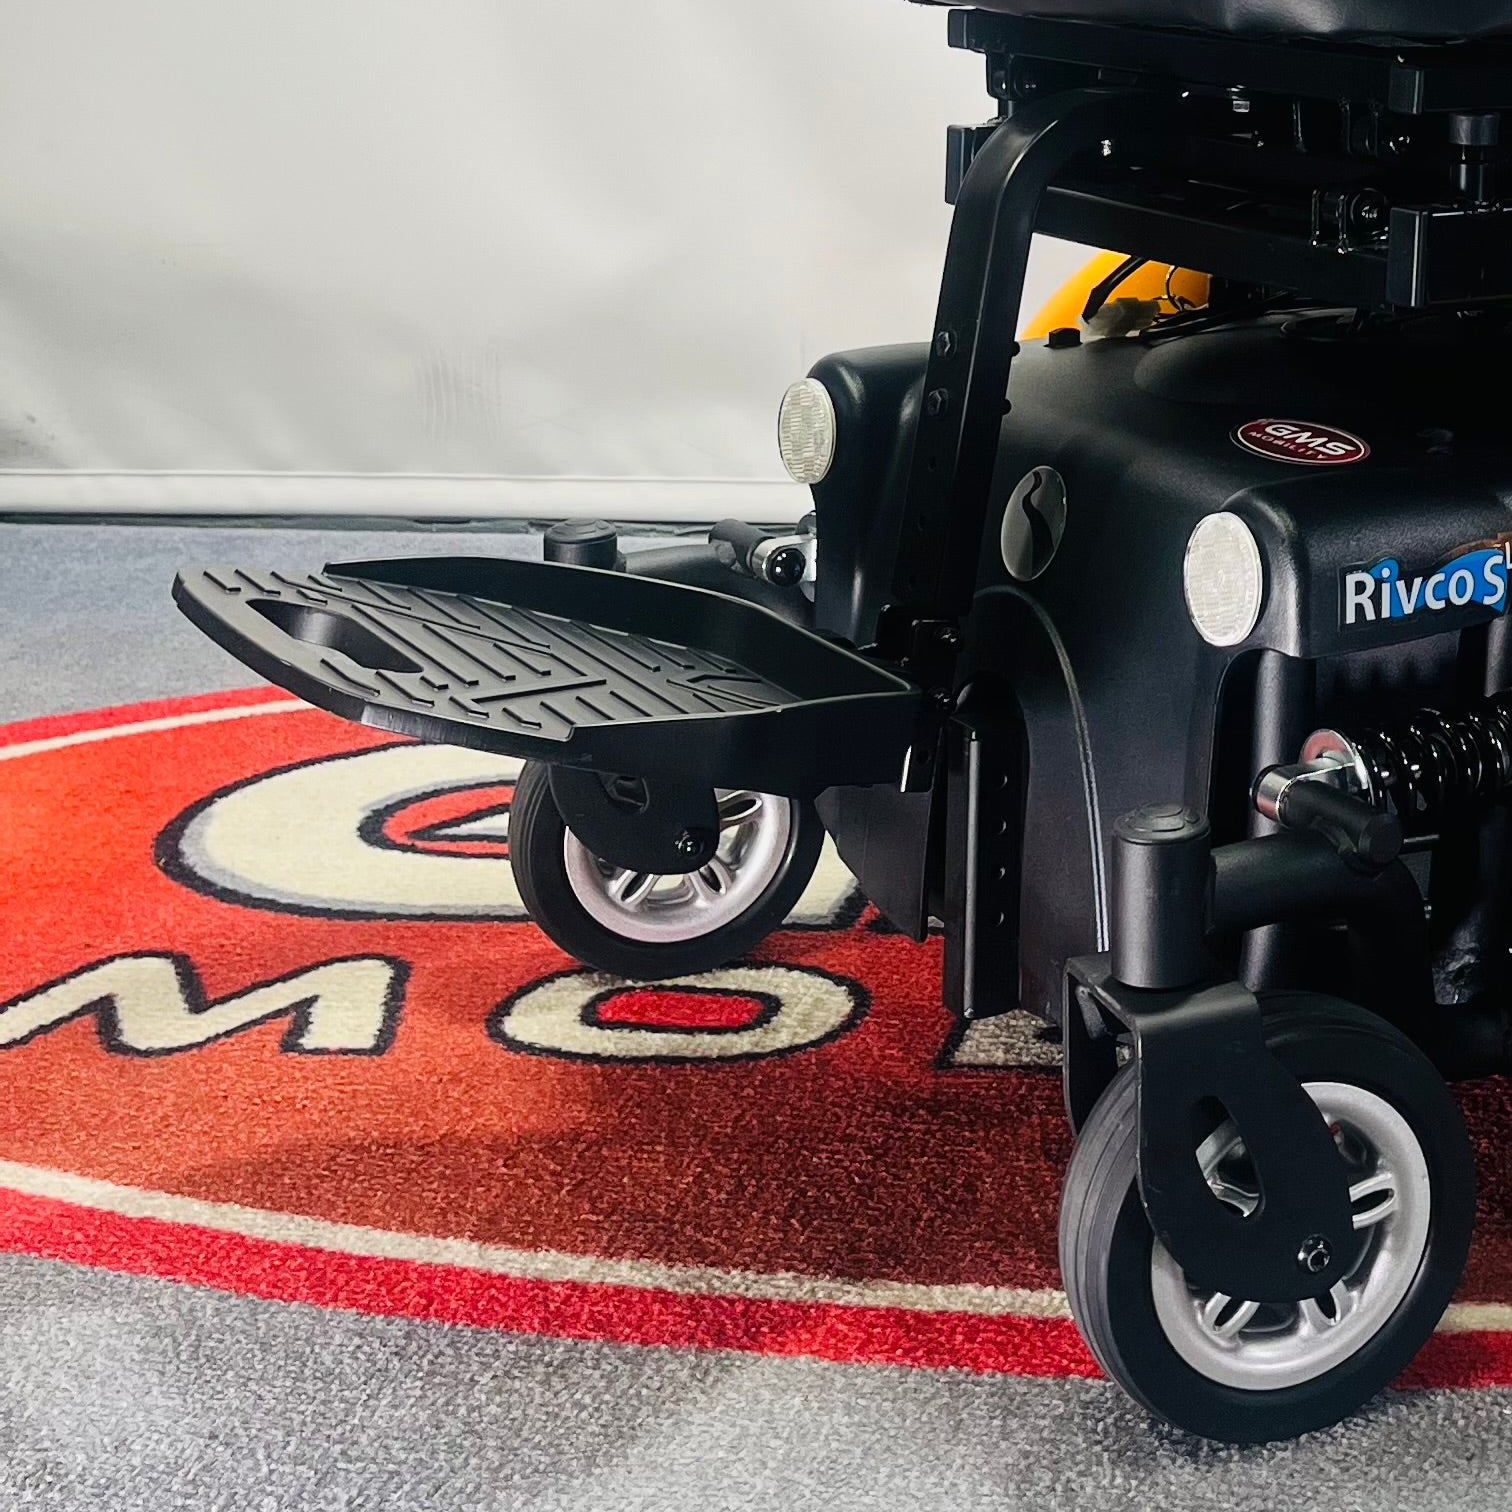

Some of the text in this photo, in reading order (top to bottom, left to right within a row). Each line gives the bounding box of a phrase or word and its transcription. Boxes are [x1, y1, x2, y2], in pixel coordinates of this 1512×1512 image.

[1248, 431, 1329, 460] MOBILITY
[1264, 424, 1357, 456] GMS
[1345, 566, 1475, 625] Rivco
